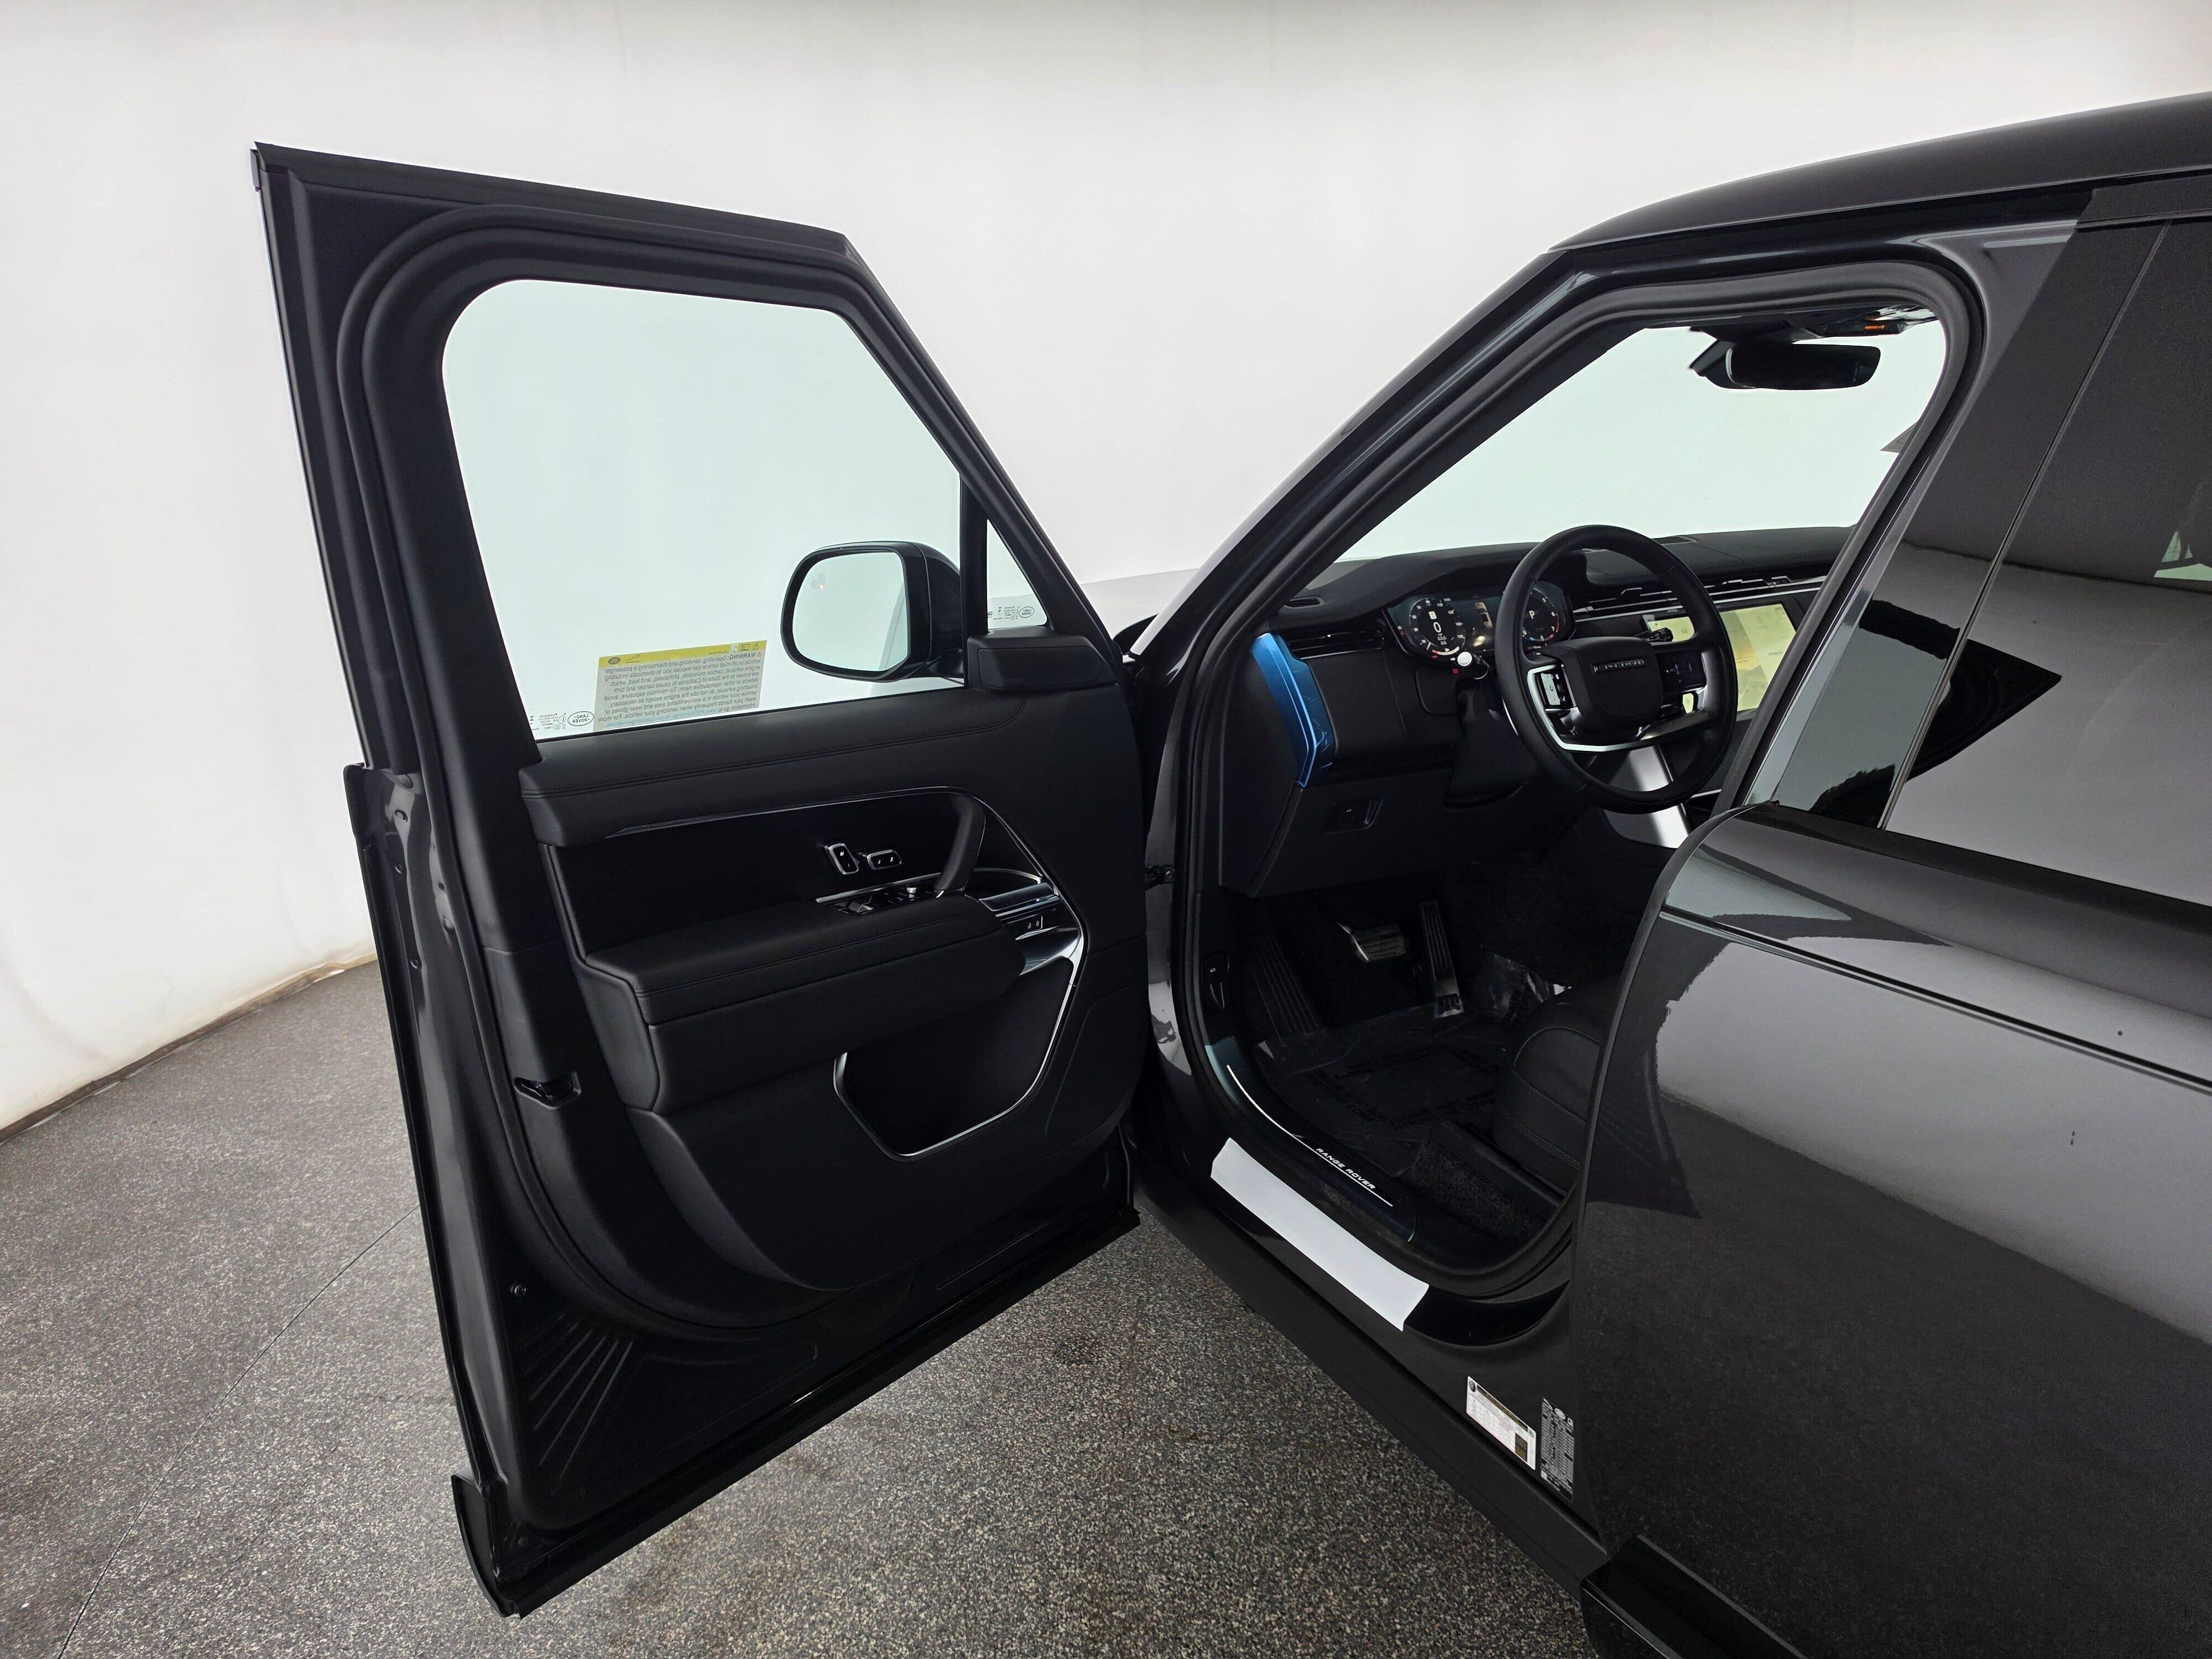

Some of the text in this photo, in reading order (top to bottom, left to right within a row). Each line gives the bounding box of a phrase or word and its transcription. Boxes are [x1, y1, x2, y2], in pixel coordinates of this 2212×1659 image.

[1529, 611, 1535, 619] P
[1433, 622, 1441, 633] 0
[1316, 1148, 1375, 1189] RANGE ROVER
